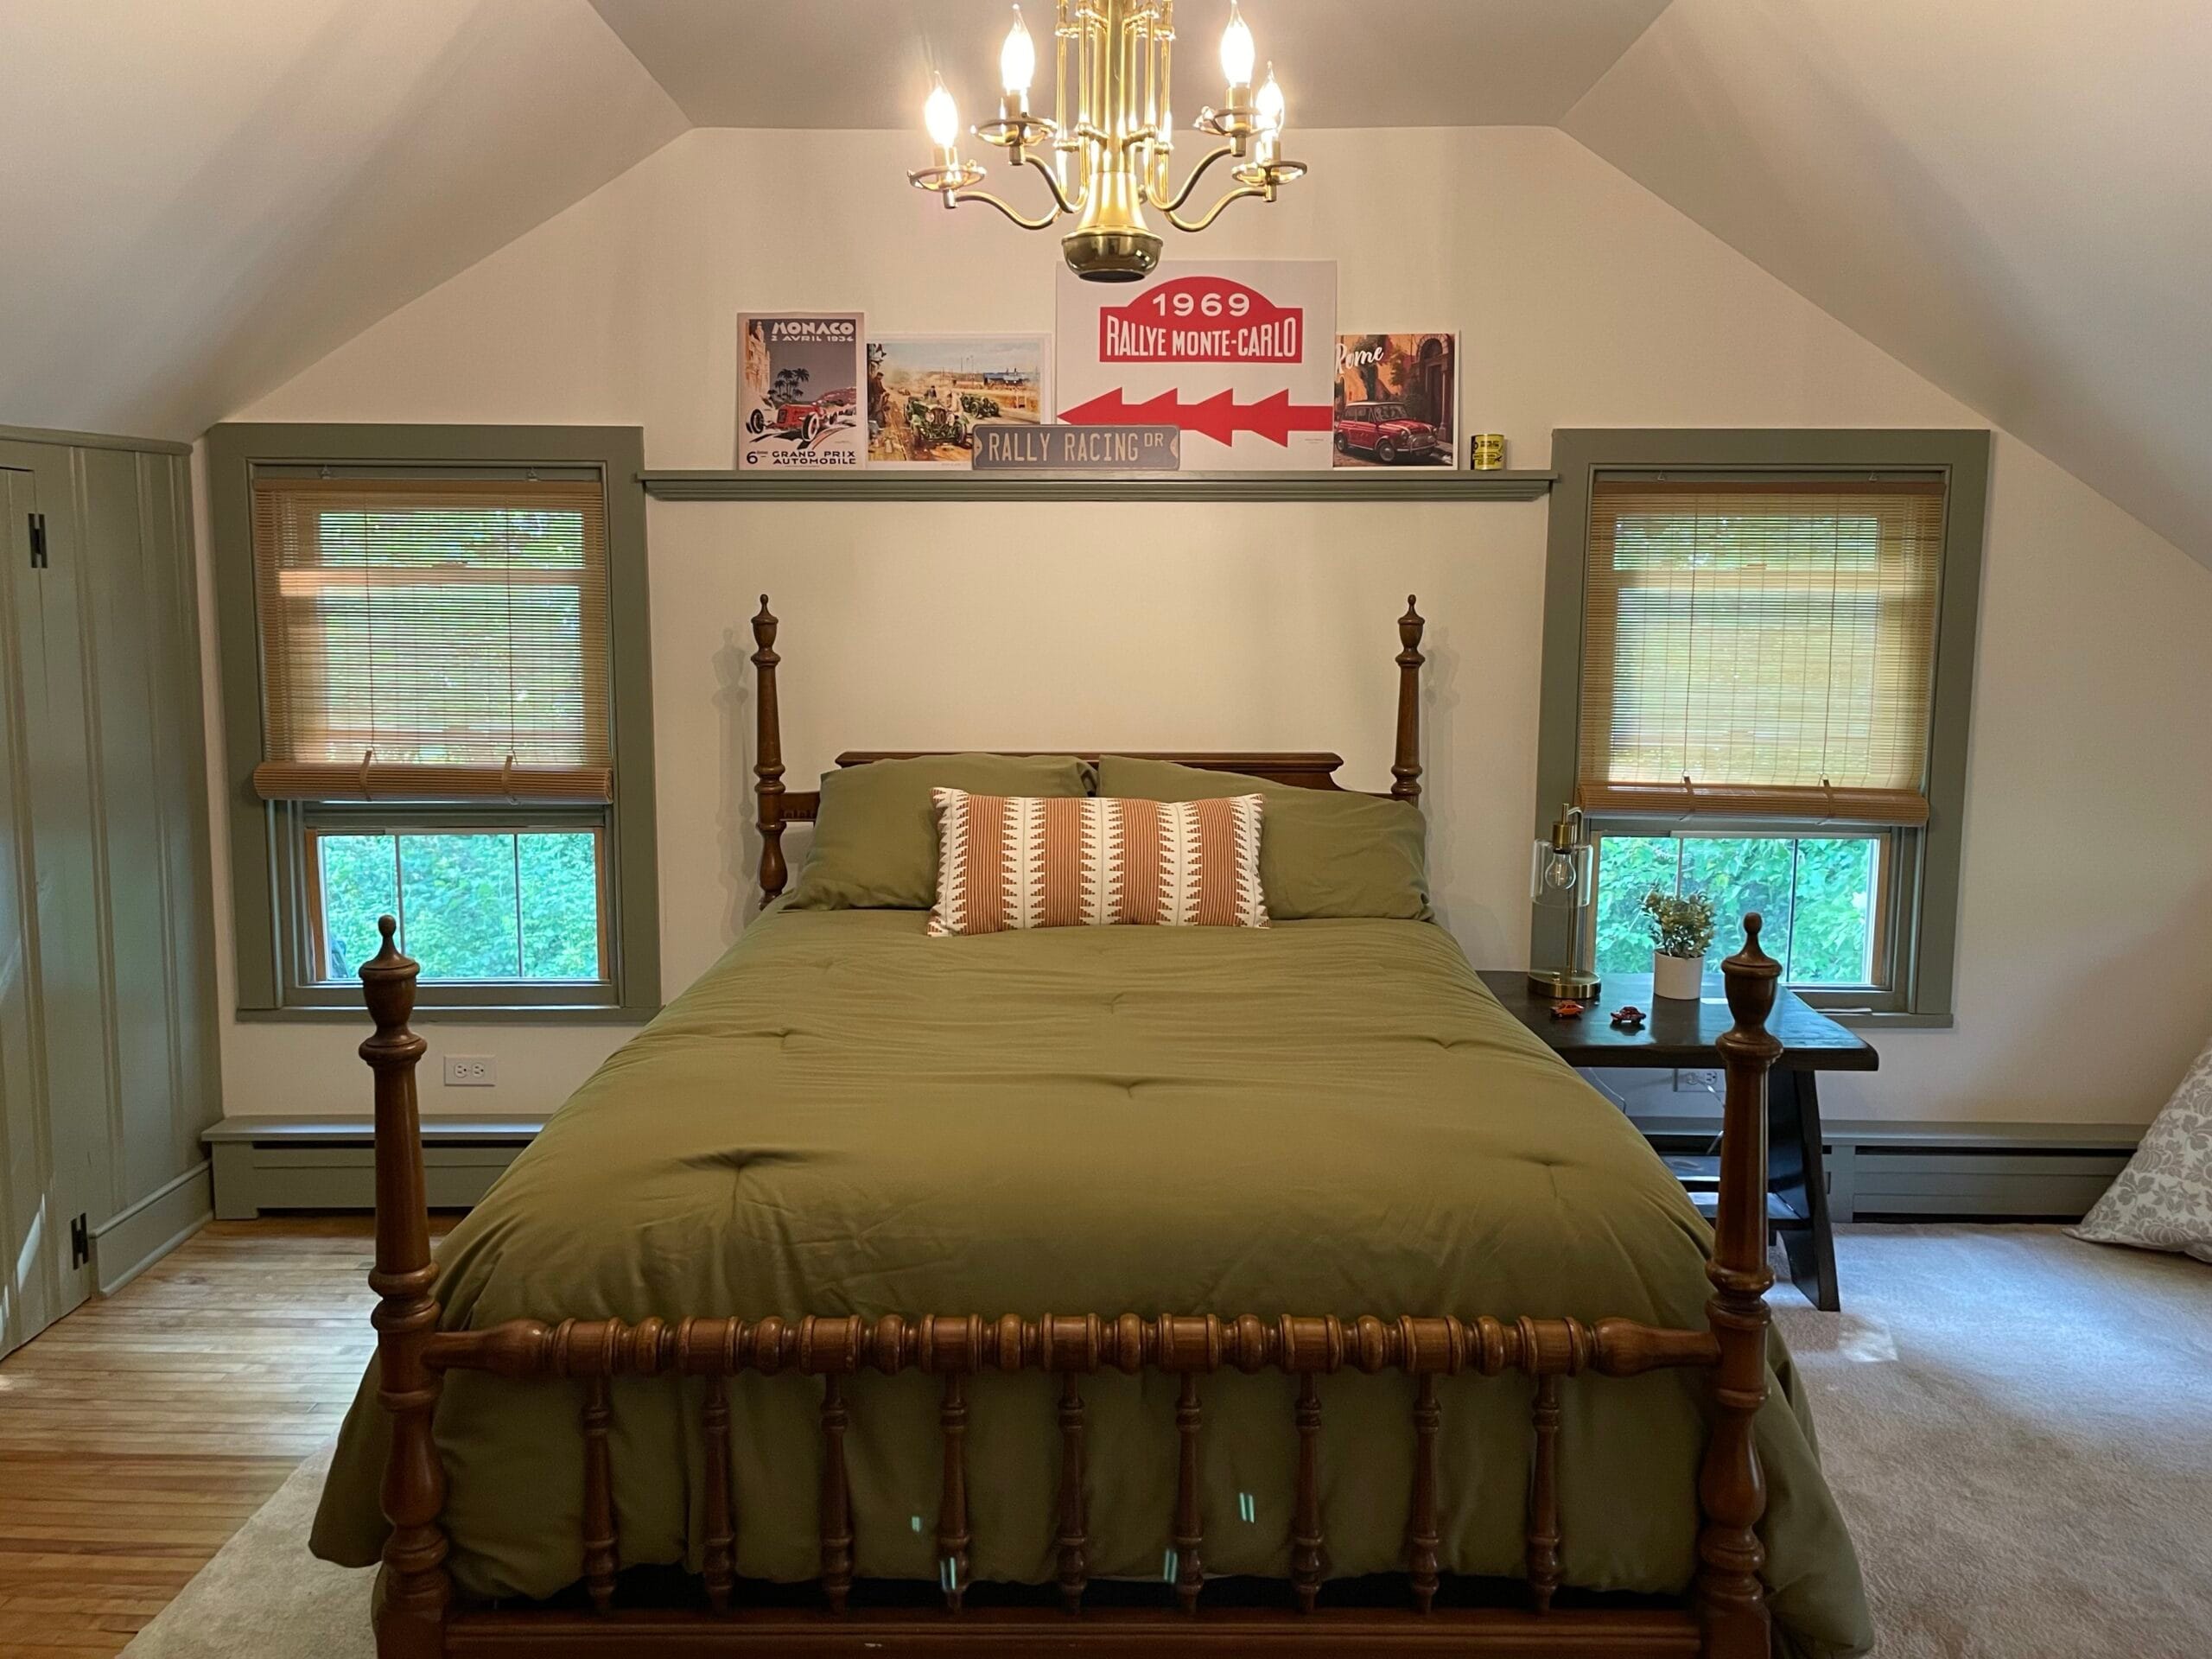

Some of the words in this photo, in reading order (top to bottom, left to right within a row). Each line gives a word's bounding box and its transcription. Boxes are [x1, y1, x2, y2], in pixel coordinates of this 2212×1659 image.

[1153, 292, 1250, 316] 1969
[772, 321, 855, 335] MONACO
[1107, 315, 1166, 356] RALLYE
[1172, 317, 1296, 357] MONTE-CARLO
[1335, 343, 1384, 374] Rome
[988, 433, 1051, 461] RALLY
[1065, 433, 1138, 461] RACING
[1144, 433, 1164, 447] DR
